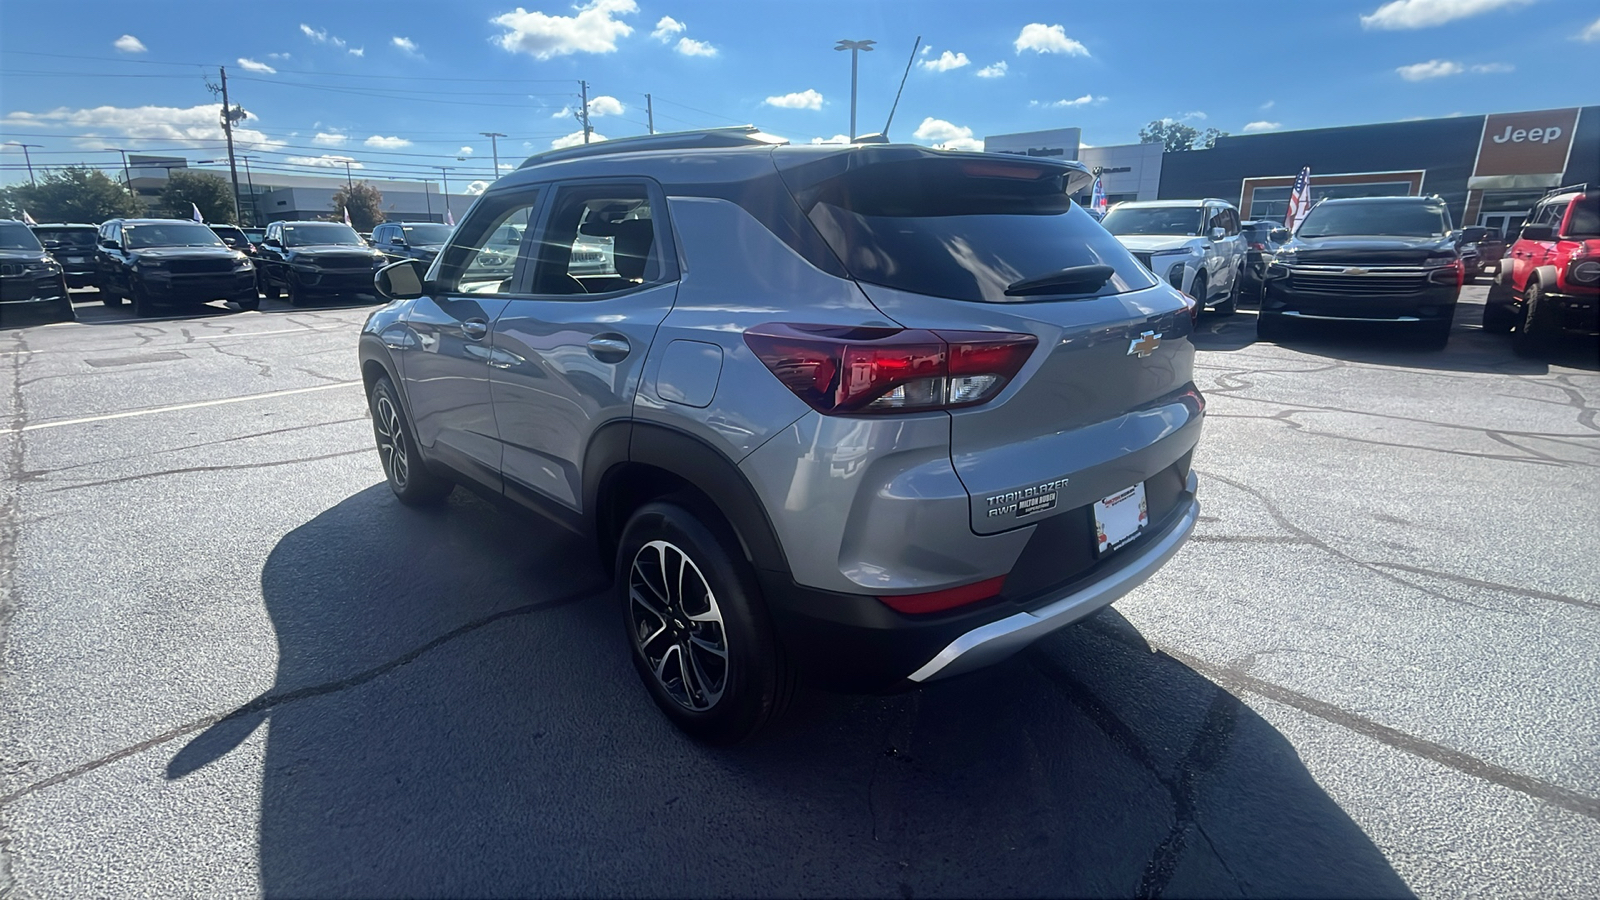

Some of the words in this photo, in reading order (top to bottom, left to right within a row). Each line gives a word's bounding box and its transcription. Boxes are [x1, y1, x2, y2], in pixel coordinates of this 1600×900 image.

[1493, 125, 1562, 144] Jeep
[986, 478, 1069, 506] TRAILBLAZER
[988, 504, 1017, 517] AWD
